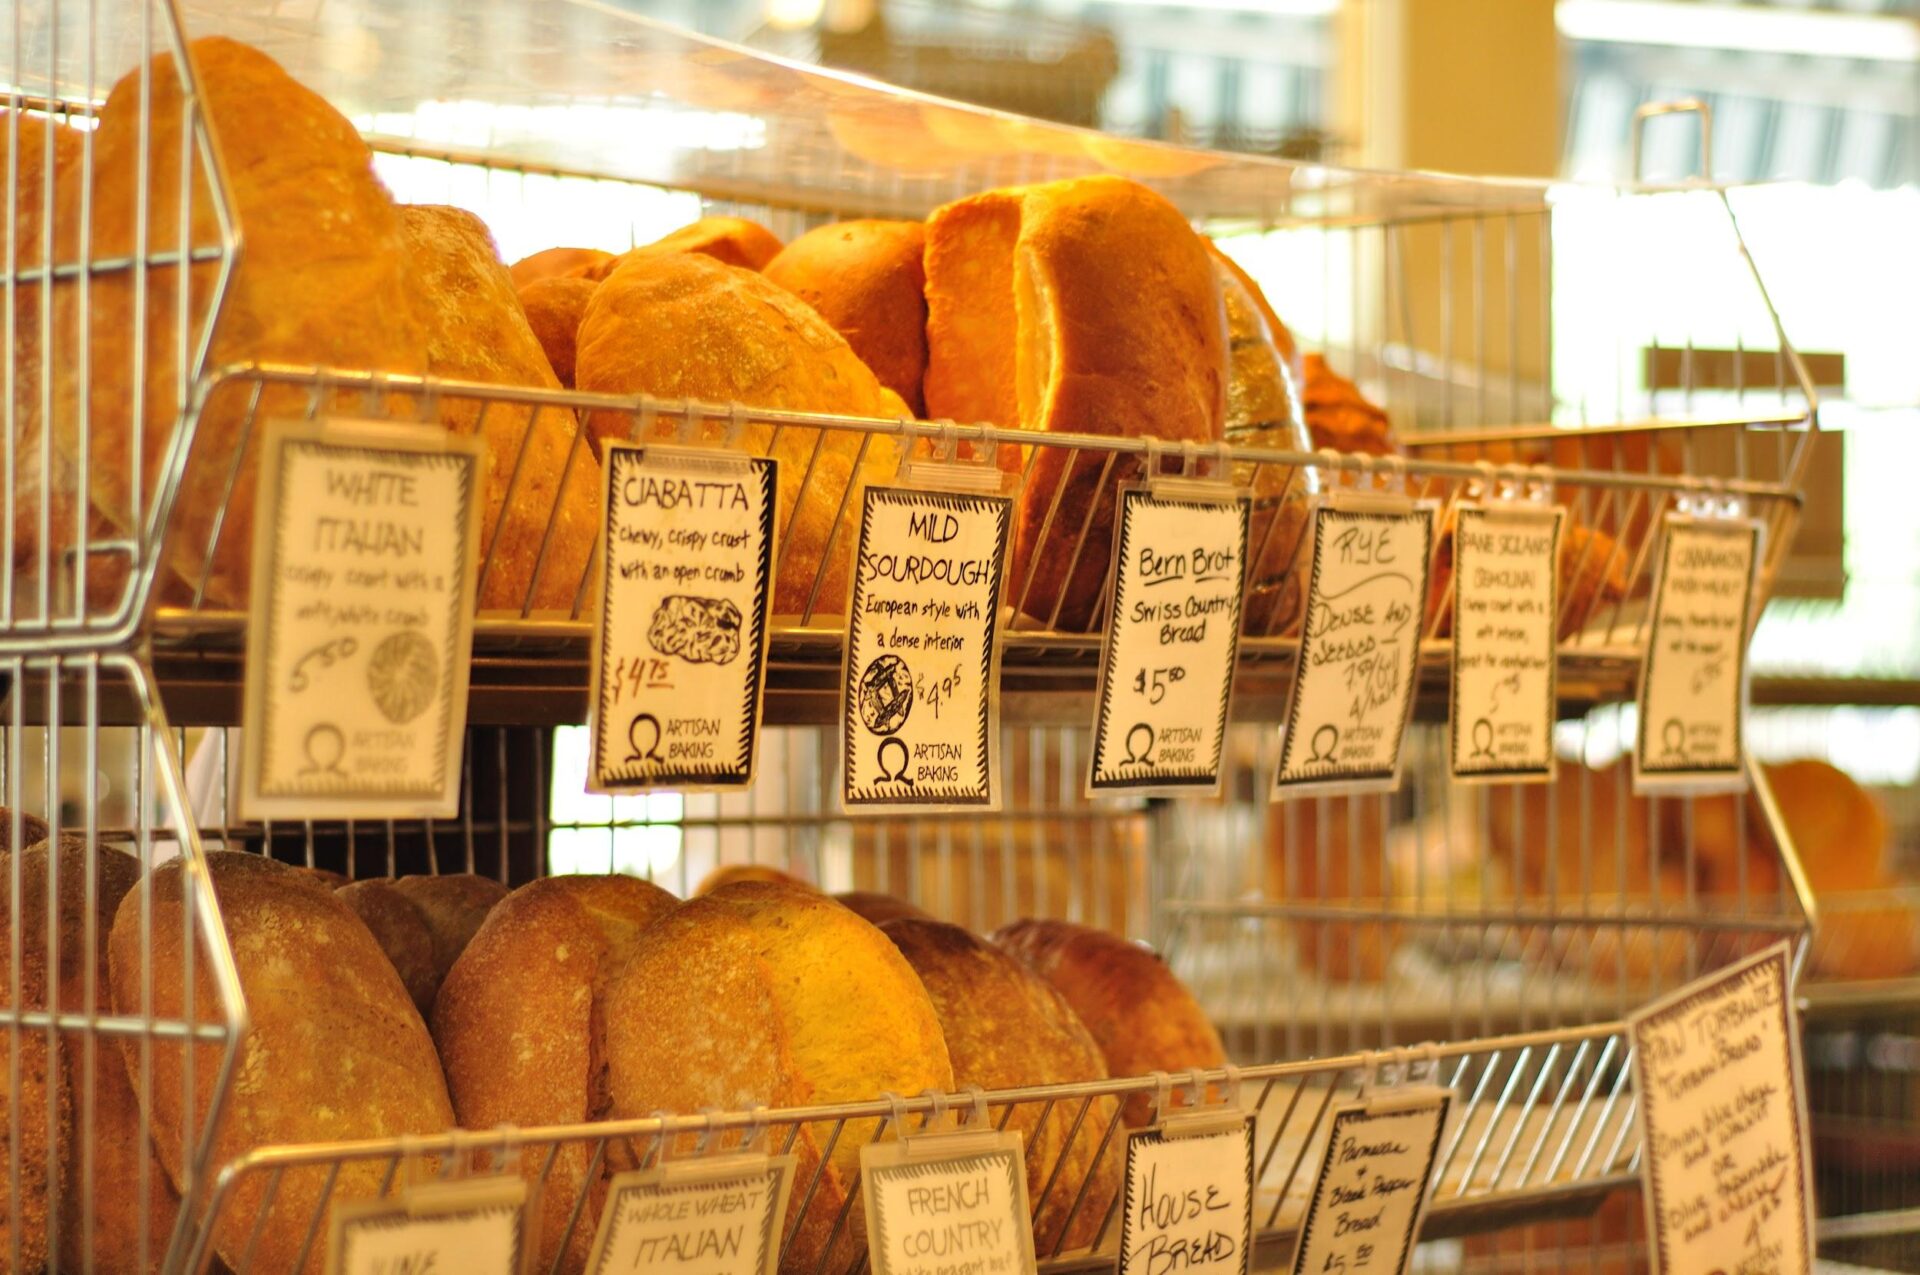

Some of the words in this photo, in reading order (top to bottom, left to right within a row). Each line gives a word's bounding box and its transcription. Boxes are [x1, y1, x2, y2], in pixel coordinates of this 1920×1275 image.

[326, 469, 419, 507] WHITE
[623, 476, 749, 511] CIABATTA
[314, 517, 424, 556] ITALIAN
[668, 529, 707, 551] crispy
[711, 529, 752, 549] crust
[908, 511, 960, 544] MILD
[1332, 526, 1396, 565] RYE
[620, 559, 648, 581] with
[653, 564, 669, 580] an
[674, 565, 700, 587] open
[705, 562, 745, 583] crumb
[866, 553, 990, 587] SOURDOUGH
[1139, 547, 1187, 577] Bern
[1192, 547, 1235, 577] Brot
[865, 594, 918, 620] European
[922, 598, 950, 622] style
[955, 603, 980, 621] with
[1130, 601, 1182, 623] Swiss
[1185, 595, 1235, 621] Country
[1313, 602, 1375, 638] DENSE
[876, 632, 886, 648] a
[889, 626, 920, 648] dense
[923, 631, 965, 651] interior
[1159, 618, 1207, 646] Bread
[665, 717, 722, 737] ARTISAN
[1158, 727, 1204, 744] ARTISAN
[668, 741, 715, 760] BAKING
[913, 742, 963, 761] ARTISAN
[1158, 748, 1196, 764] BAKING
[917, 765, 959, 783] BAKING
[627, 1201, 690, 1224] WHOLE
[695, 1190, 764, 1217] WHEAT
[907, 1176, 990, 1216] FRENCH
[1140, 1162, 1231, 1231] HOUSE
[633, 1225, 745, 1270] ITALIAN
[902, 1217, 1003, 1258] COUNTRY
[1126, 1230, 1235, 1275] BREAD
